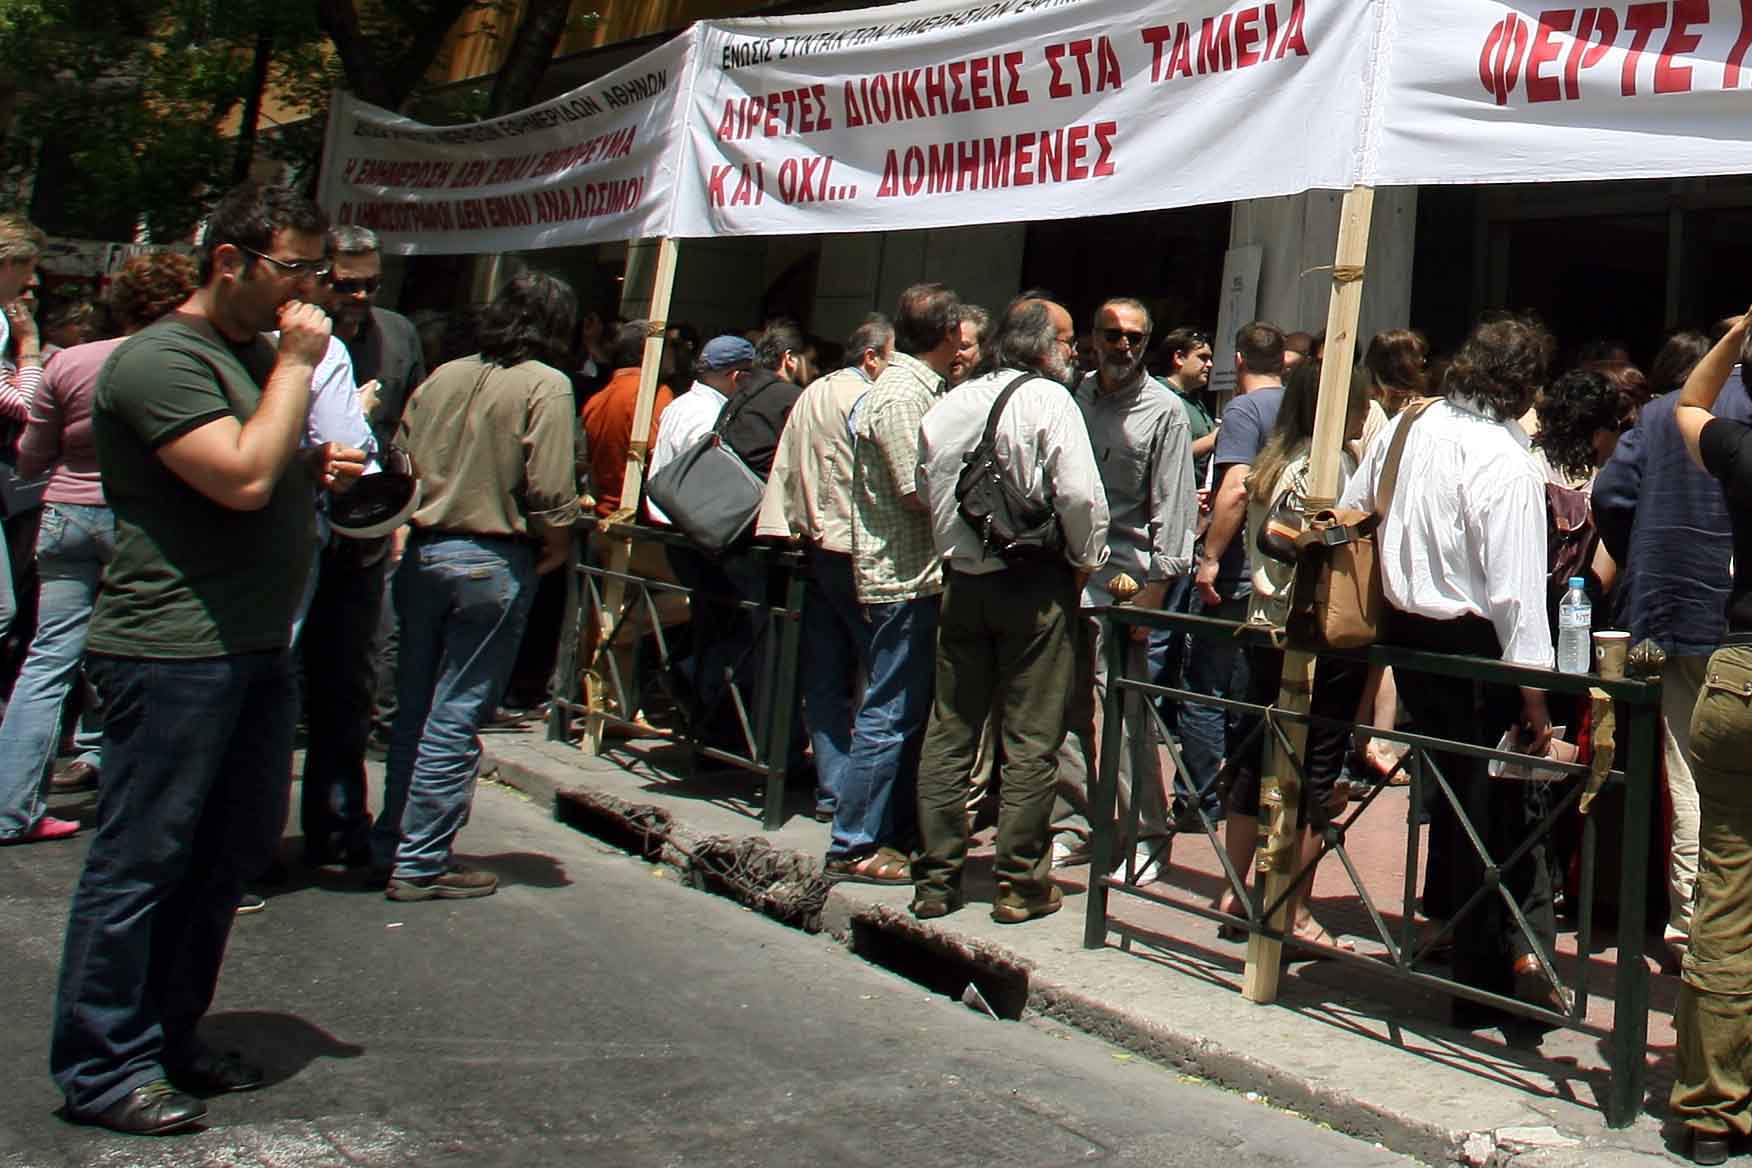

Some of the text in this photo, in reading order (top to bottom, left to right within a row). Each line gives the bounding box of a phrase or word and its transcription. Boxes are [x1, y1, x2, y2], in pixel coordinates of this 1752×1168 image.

[723, 38, 775, 69] ΕΝΩΣΙΣ
[604, 70, 667, 109] ΑΘΗΝΩΝ
[718, 85, 832, 143] ΑΙΡΕΤΕΣ
[844, 51, 1029, 128] ΔΙΟΙΚΗΣΕΙΣ
[1047, 36, 1123, 99] ΣΤΑ
[709, 160, 765, 207] ΚΑΙ
[877, 121, 1117, 197] ΔΟΜΗΜΕΝΕΣ
